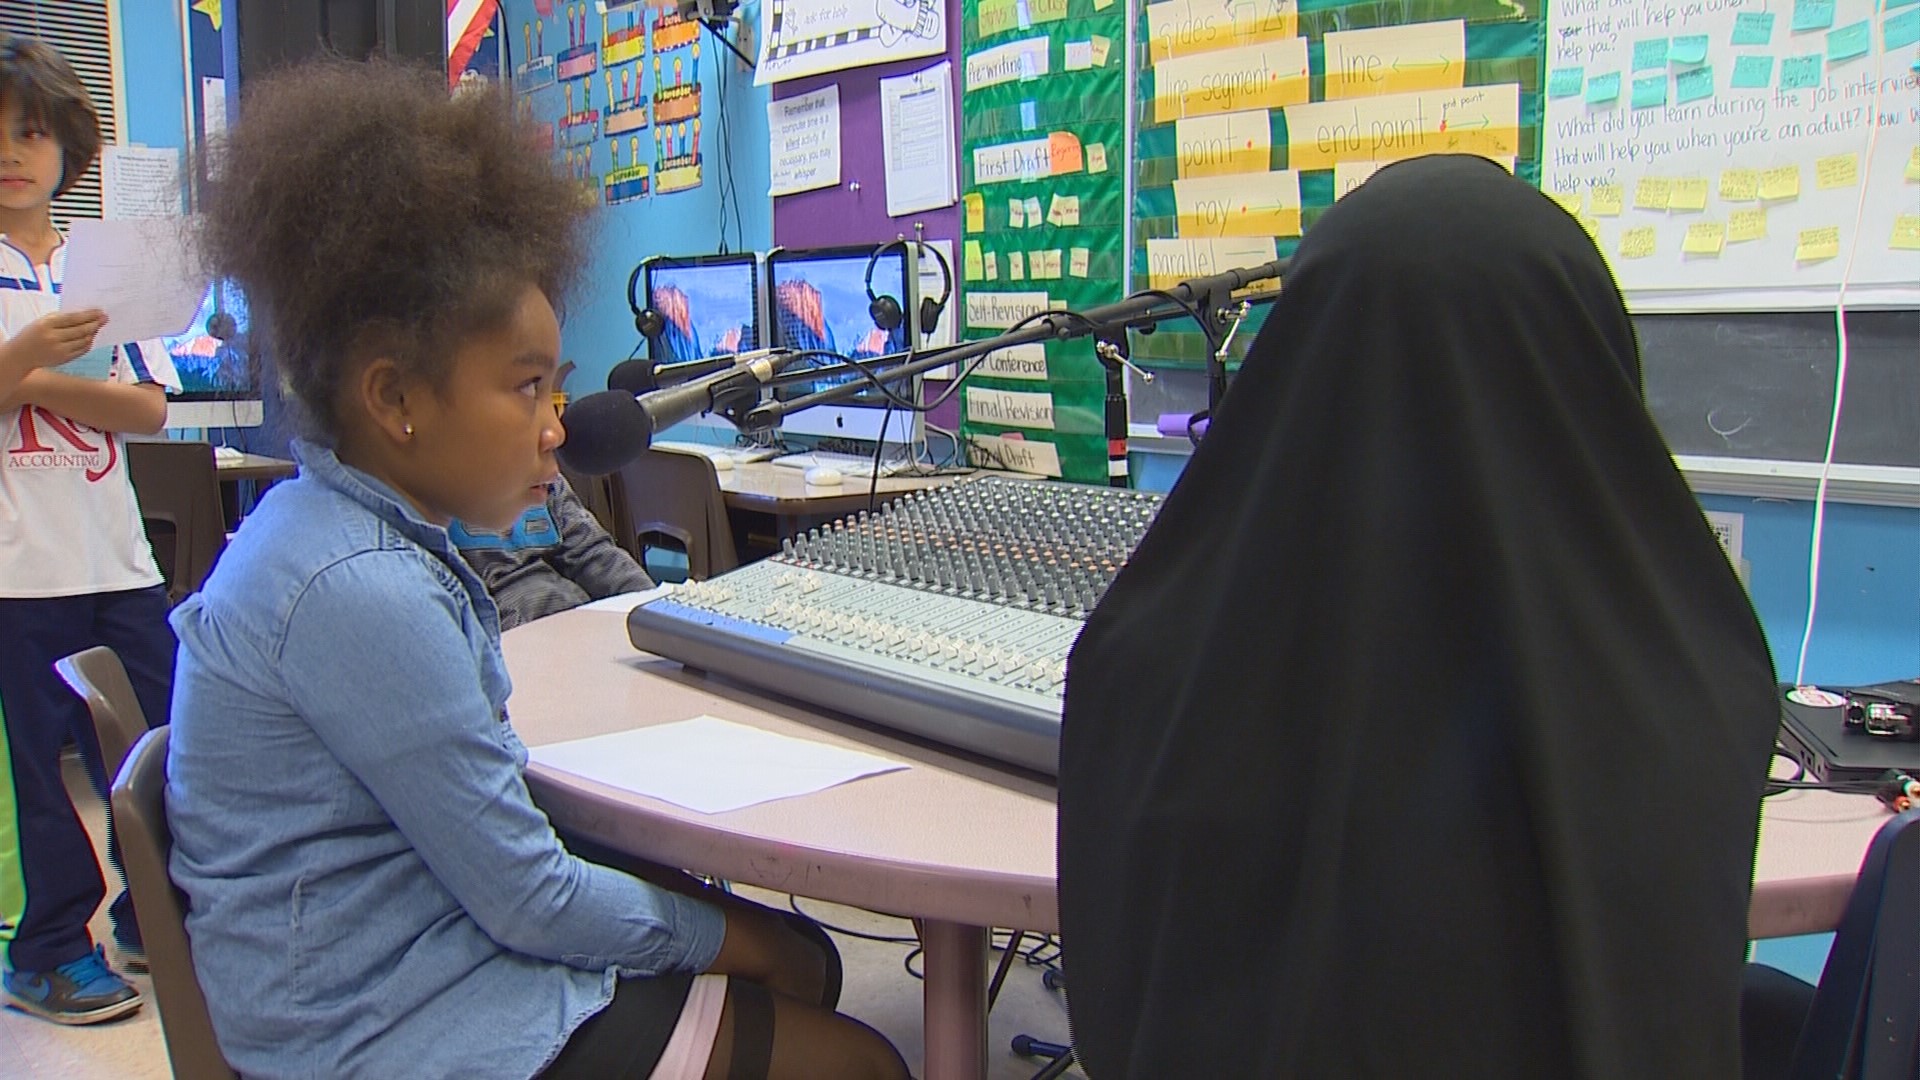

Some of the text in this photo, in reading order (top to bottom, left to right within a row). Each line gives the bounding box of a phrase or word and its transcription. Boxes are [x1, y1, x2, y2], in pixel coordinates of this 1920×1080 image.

[1159, 0, 1217, 50] sides
[1584, 15, 1611, 36] that
[1616, 8, 1639, 30] will
[1645, 4, 1676, 28] help
[1680, 2, 1703, 26] you
[1338, 44, 1385, 85] line
[1557, 41, 1583, 62] help
[1588, 32, 1617, 62] you?
[1165, 52, 1270, 110] line segment
[1558, 112, 1596, 140] What
[1603, 108, 1626, 134] did
[1630, 108, 1655, 140] you
[1663, 95, 1702, 124] learn
[1707, 95, 1767, 128] during
[1773, 86, 1801, 110] the
[1811, 77, 1838, 112] job
[1844, 72, 1920, 95] intervie
[1182, 116, 1237, 179] point
[1317, 97, 1428, 161] end point
[1555, 147, 1579, 168] that
[1583, 143, 1605, 165] will
[1610, 139, 1640, 163] help
[1644, 142, 1672, 165] you
[1676, 127, 1718, 152] when
[1724, 124, 1771, 158] you're
[1778, 123, 1801, 140] an
[1806, 106, 1863, 136] adult?
[979, 147, 1050, 177] First Draft
[1553, 172, 1581, 193] help
[1194, 197, 1232, 238] ray
[1152, 239, 1217, 290] parallel
[989, 350, 1045, 374] Conference
[969, 391, 1052, 421] Final Revision
[8, 454, 100, 468] ACCOUNTING
[1003, 444, 1035, 469] Draft
